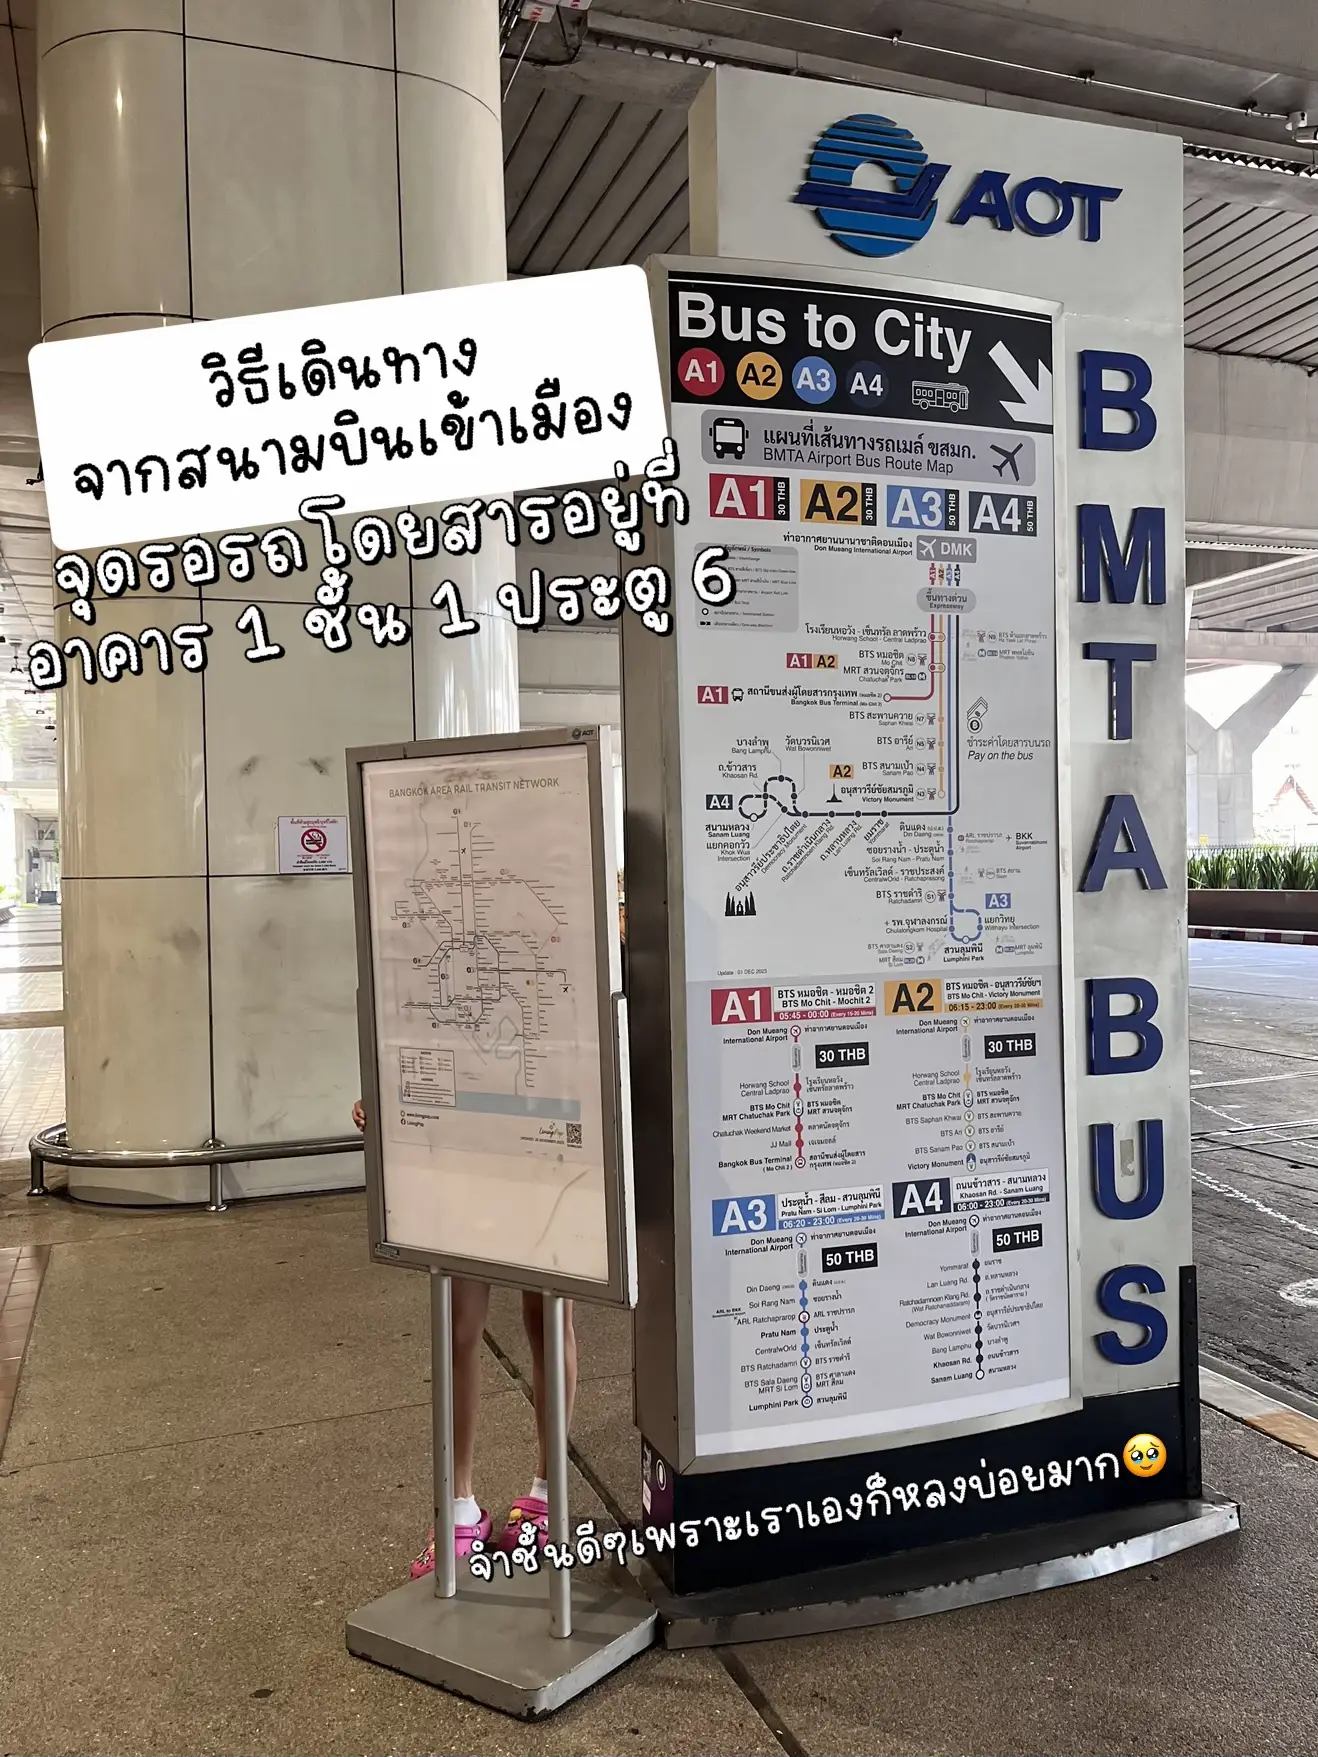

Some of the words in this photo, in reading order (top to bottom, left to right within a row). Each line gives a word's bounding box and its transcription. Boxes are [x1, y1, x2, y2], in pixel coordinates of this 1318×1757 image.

[951, 169, 1123, 243] AOT
[678, 291, 786, 342] Bus
[804, 304, 856, 350] to
[874, 309, 972, 373] City
[684, 358, 718, 383] A1
[741, 363, 778, 388] A2
[796, 367, 831, 391] A3
[849, 372, 883, 397] A4
[764, 420, 923, 455] แผนที่เส้นทางรถเมล์
[928, 440, 976, 460] ขสมก.
[764, 448, 804, 463] BMTA
[808, 451, 851, 468] Airport
[856, 455, 881, 468] Bus
[885, 457, 922, 471] Route
[927, 459, 954, 474] Map
[714, 477, 765, 516] A1
[778, 481, 786, 500] THB
[865, 487, 874, 505] THB
[805, 483, 859, 522] A2
[891, 488, 943, 527] A3
[948, 493, 956, 510] THB
[972, 495, 1021, 532] A4
[941, 542, 972, 556] DMK
[790, 655, 807, 667] A1
[817, 656, 835, 667] A2
[702, 688, 723, 702] A1
[968, 751, 985, 762] Pay
[1001, 751, 1015, 760] the
[1017, 751, 1033, 760] bus
[833, 765, 851, 777] A2
[389, 786, 428, 798] BANGKOK
[430, 786, 452, 795] AREA
[454, 784, 472, 793] RAIL
[475, 782, 511, 792] TRANSIT
[514, 778, 559, 789] NETWORK
[709, 796, 729, 808] A4
[988, 895, 1008, 907] A3
[946, 983, 960, 991] BTS
[778, 990, 795, 998] BTS
[892, 983, 934, 1013] A2
[989, 991, 1008, 999] Victory
[721, 990, 762, 1022] A1
[814, 998, 831, 1006] Chit
[838, 997, 864, 1005] Mochit
[948, 1003, 969, 1012] 06:15
[976, 1002, 997, 1010] 23:00
[779, 1012, 800, 1020] 05:45
[808, 1010, 829, 1018] 00:00
[763, 1027, 788, 1036] Mueang
[723, 1036, 764, 1045] International
[766, 1035, 788, 1043] Airport
[988, 1041, 1002, 1052] 30
[1006, 1039, 1033, 1051] THB
[819, 1050, 834, 1062] 30
[838, 1048, 865, 1061] THB
[912, 1101, 945, 1110] Chatuchak
[739, 1112, 774, 1121] Chatuchak
[719, 1160, 748, 1168] Bangkok
[765, 1156, 792, 1165] Terminal
[908, 1162, 929, 1171] Victory
[932, 1159, 964, 1168] Monument
[1025, 1185, 1043, 1193] Luang
[900, 1182, 943, 1216] A4
[957, 1202, 979, 1211] 06:00
[985, 1200, 1004, 1208] 23:00
[841, 1204, 867, 1212] Lumphini
[720, 1198, 767, 1233] A3
[783, 1220, 805, 1229] 06:20
[813, 1216, 835, 1226] 23:00
[996, 1234, 1010, 1246] 50
[1014, 1230, 1039, 1243] THB
[826, 1253, 841, 1266] 50
[846, 1250, 874, 1264] THB
[761, 1331, 779, 1339] Pratu
[933, 1360, 960, 1368] Khaosan
[931, 1375, 953, 1384] Sanam
[954, 1372, 972, 1381] Luang
[749, 1401, 782, 1411] Lumphini
[784, 1399, 798, 1408] Park
